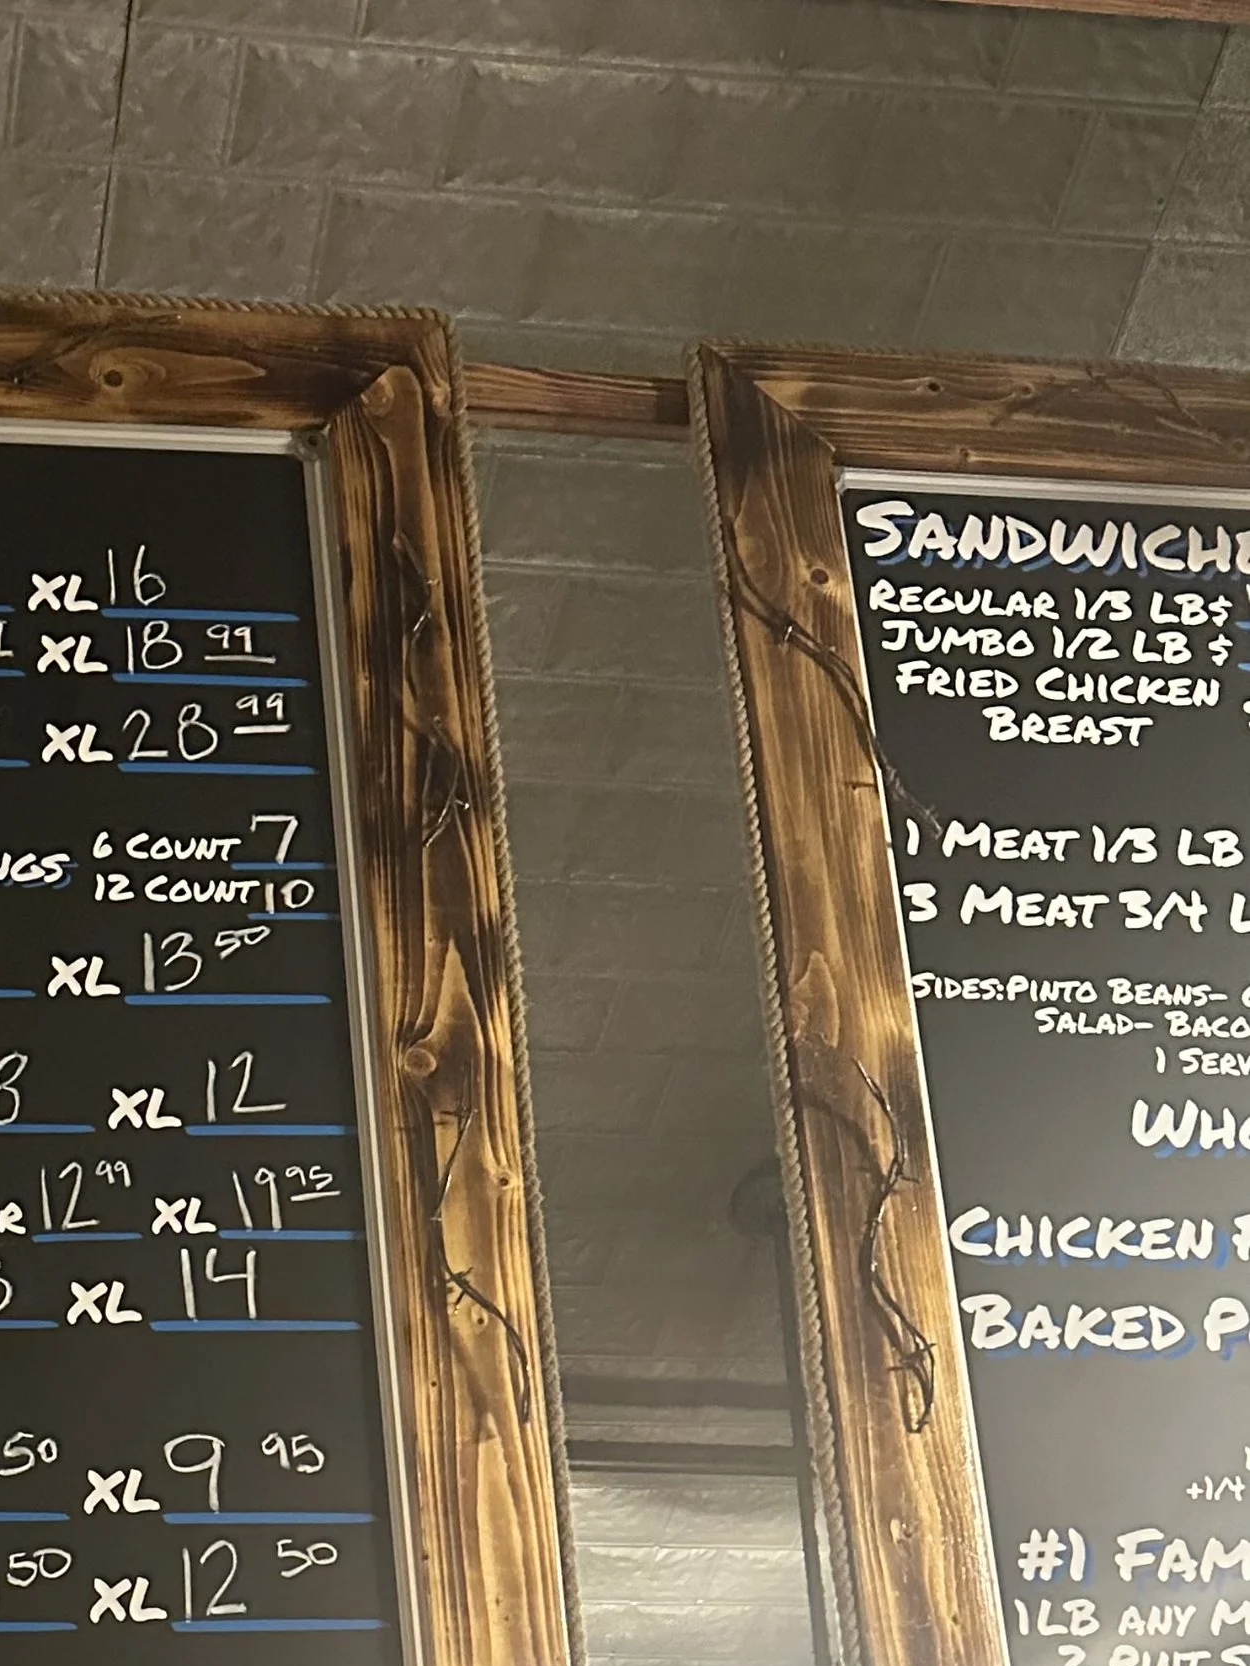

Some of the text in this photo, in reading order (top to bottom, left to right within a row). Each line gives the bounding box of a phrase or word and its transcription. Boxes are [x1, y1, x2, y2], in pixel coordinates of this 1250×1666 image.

[28, 574, 98, 611] XL
[108, 545, 166, 605] 16
[870, 579, 1132, 621] REGULAR 1/3
[37, 635, 108, 673] XL
[882, 620, 1034, 656] JUMBO
[1053, 626, 1119, 659] 1/2
[896, 661, 1219, 706] FRIED CHICKEN
[42, 724, 113, 762] XL
[982, 706, 1153, 746] BREAST
[93, 816, 298, 864] 6 COUNT 7
[907, 819, 1243, 867] 1 MEAT 1/3 LB
[95, 874, 314, 914] 12 COUNT 10
[904, 883, 1207, 932] 3 MEAT 3/4
[48, 956, 120, 996] XL
[108, 1088, 181, 1129] XL
[208, 1052, 286, 1121] 12
[152, 1198, 216, 1234] XL
[946, 1207, 1214, 1264] CHICKEN
[67, 1281, 142, 1324] XL
[181, 1248, 256, 1318] 14
[957, 1294, 1185, 1355] BAKED
[84, 1469, 160, 1514] XL
[1018, 1528, 1085, 1581] #1
[90, 1577, 167, 1623] XL
[1118, 1605, 1196, 1636] ANY
